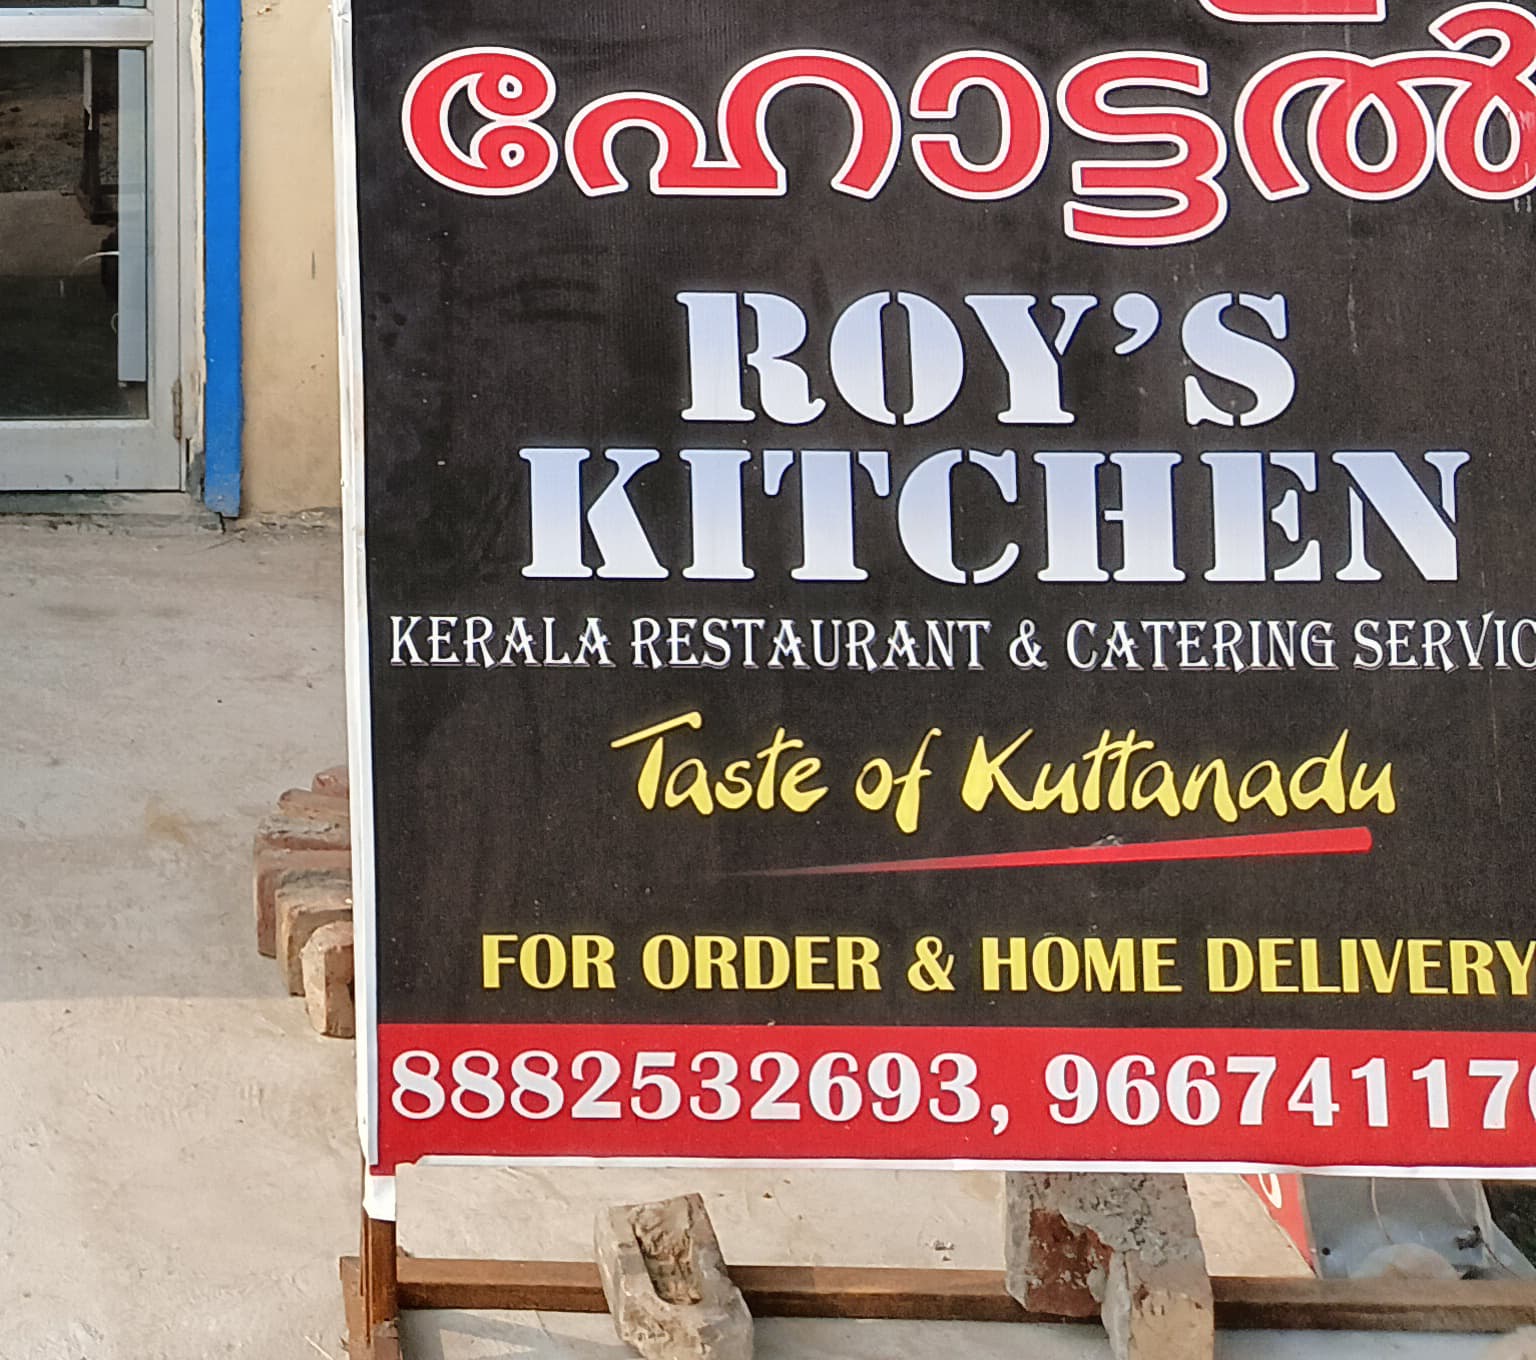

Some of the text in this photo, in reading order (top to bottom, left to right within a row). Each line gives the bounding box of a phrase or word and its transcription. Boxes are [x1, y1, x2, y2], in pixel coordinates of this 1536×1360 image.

[519, 447, 1471, 584] KITCHEN
[390, 615, 617, 670] KERALA
[631, 617, 992, 672] RESTAURANT
[1010, 618, 1048, 671] &
[1067, 618, 1337, 673] CATERING
[610, 711, 1397, 834] Taste of Kuttanadu
[482, 933, 1536, 996] FOR ORDER & HOME DELIVERY
[389, 1049, 1536, 1137] 8882532693, 96674117
